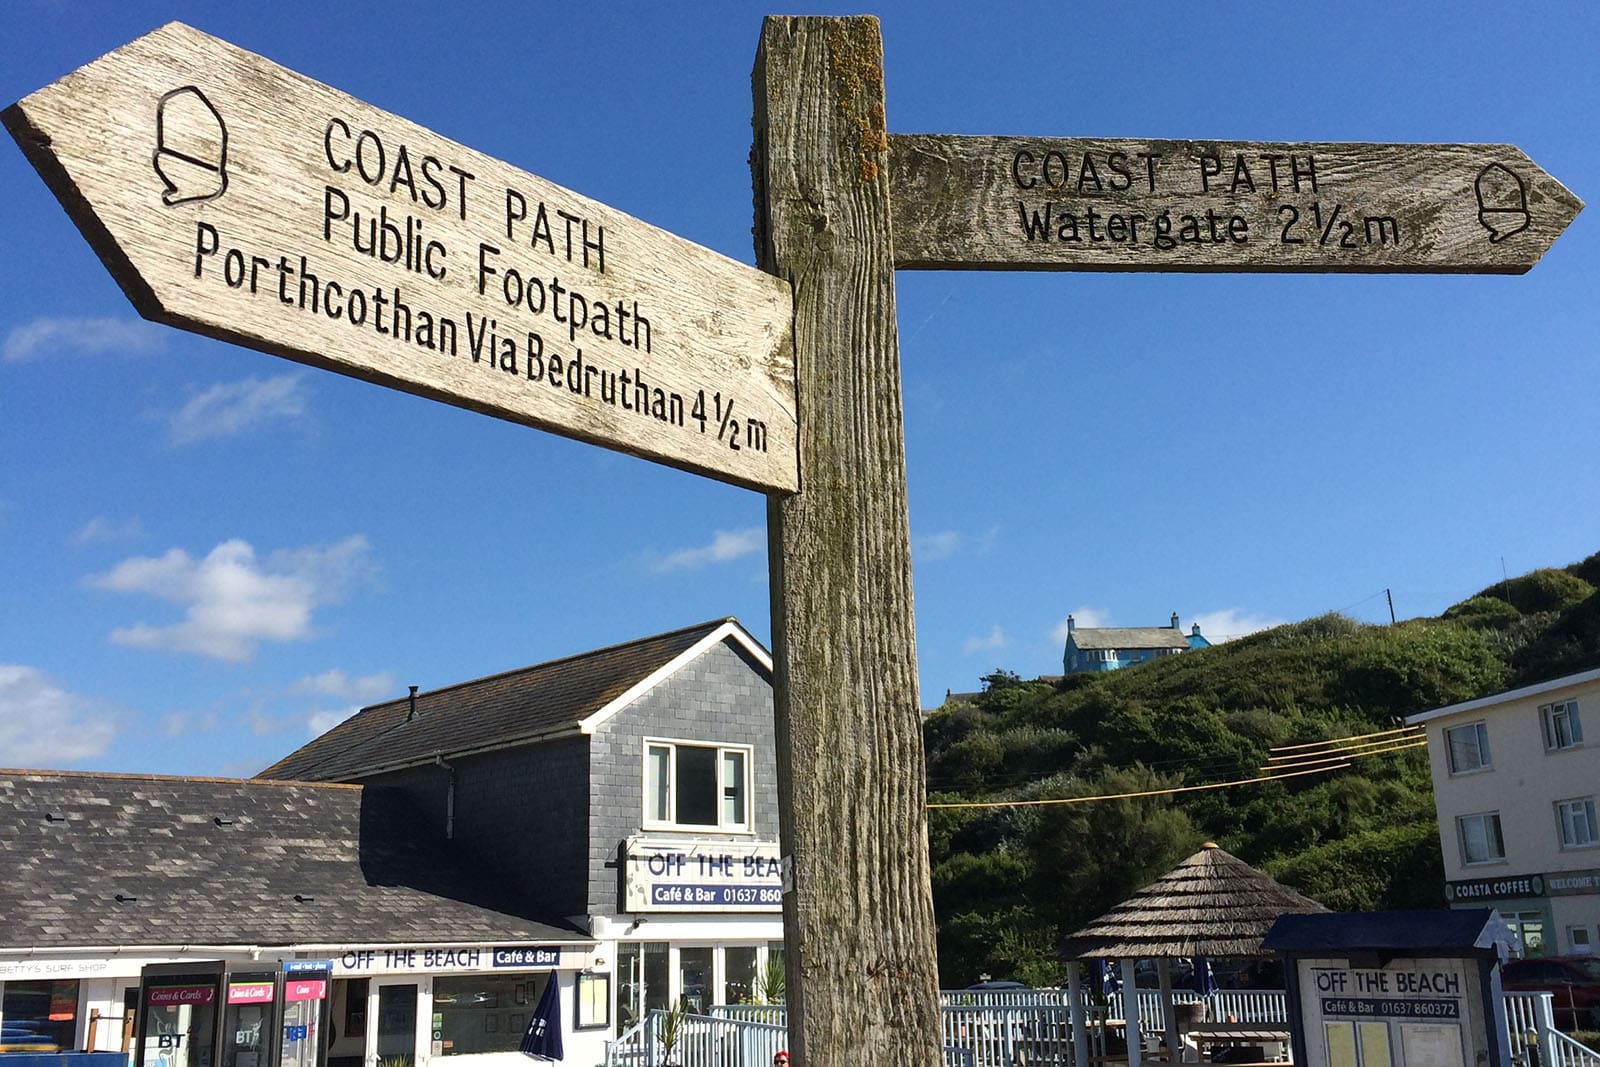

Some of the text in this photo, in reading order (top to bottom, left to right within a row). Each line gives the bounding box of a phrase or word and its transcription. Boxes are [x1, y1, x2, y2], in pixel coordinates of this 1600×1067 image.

[1012, 150, 1319, 194] COAST PATH
[324, 117, 605, 274] COAST PATH
[1018, 201, 1250, 250] Watergate
[323, 185, 652, 353] Public Footpath
[194, 221, 457, 357] Porthcothan
[466, 311, 519, 376] Via
[526, 332, 684, 427] Bedruthan
[649, 852, 686, 877] OFF
[697, 853, 734, 878] THE
[655, 886, 783, 903] Café & Bar 01637 860
[1456, 880, 1530, 898] COASTA COFFEE
[342, 951, 375, 969] OFF
[384, 950, 416, 968] THE
[423, 948, 480, 967] BEACH
[496, 950, 557, 964] Café & Bar
[78, 963, 107, 972] SHOP
[1317, 972, 1460, 993] OFF THE BEACH
[151, 990, 202, 1001] Coins & Cards
[1325, 1001, 1456, 1015] Café & Bar 01637 860372
[158, 1034, 186, 1048] BT
[236, 1030, 253, 1044] BT
